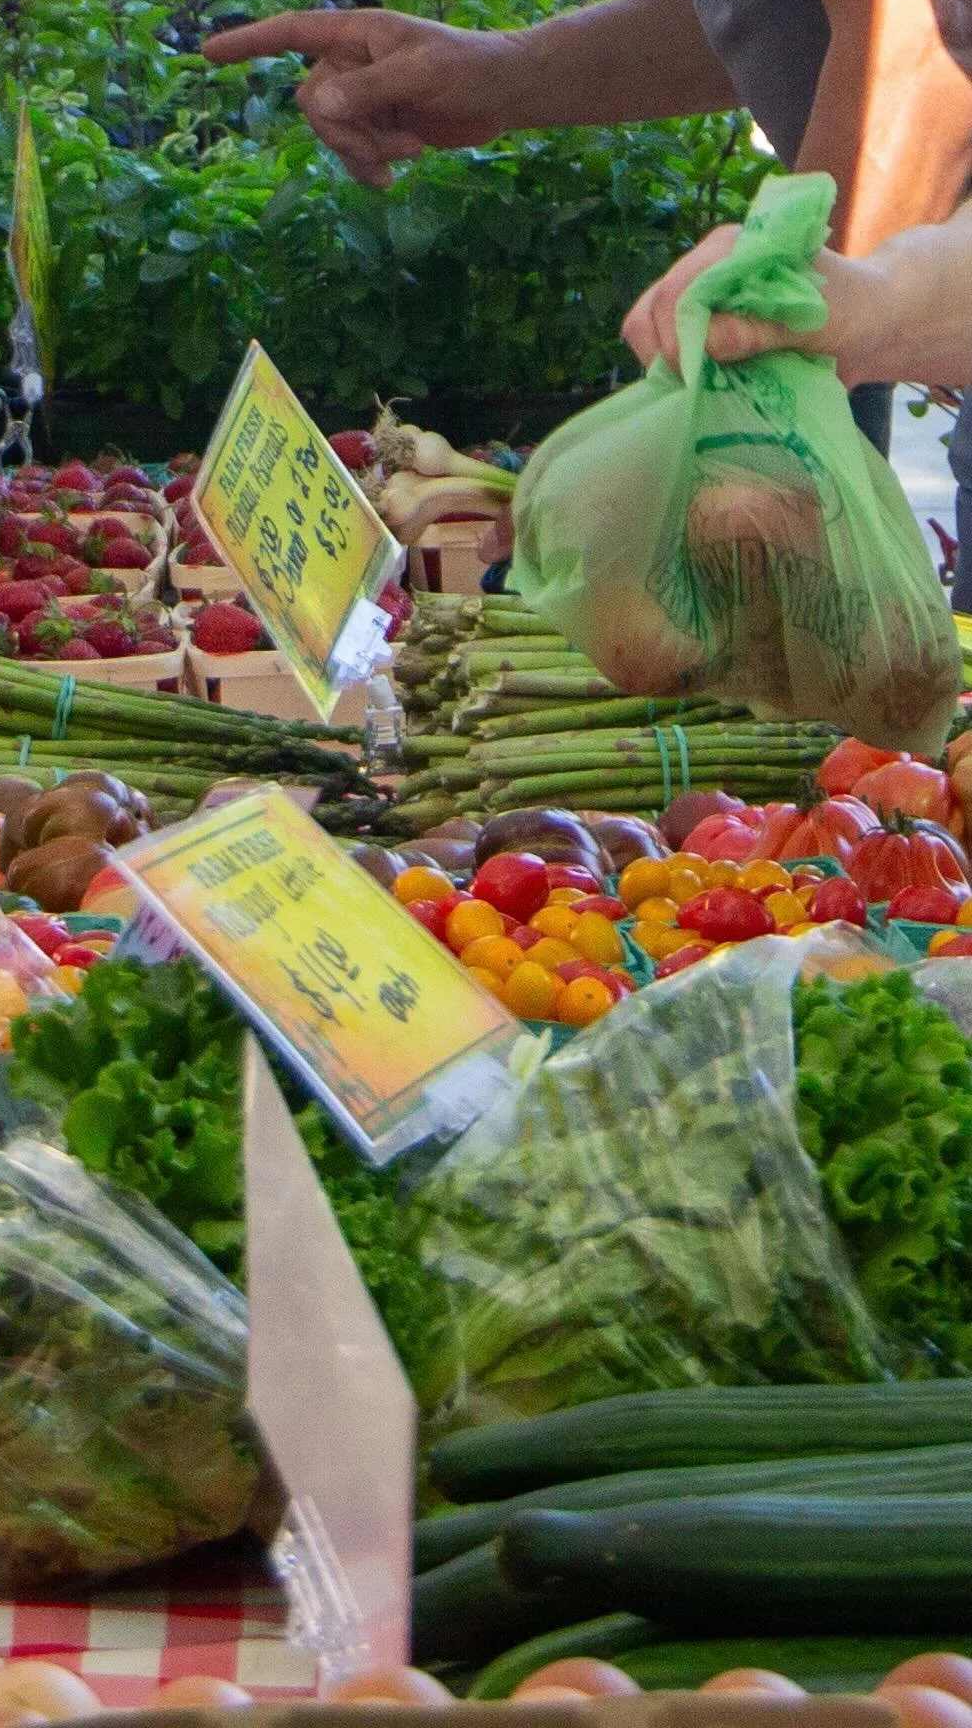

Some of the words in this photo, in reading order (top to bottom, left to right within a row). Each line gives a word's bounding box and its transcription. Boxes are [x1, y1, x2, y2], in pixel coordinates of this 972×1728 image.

[220, 456, 244, 498] FARM
[236, 404, 265, 460] FRESH
[188, 848, 244, 889] FARM
[228, 829, 284, 869] FRESH
